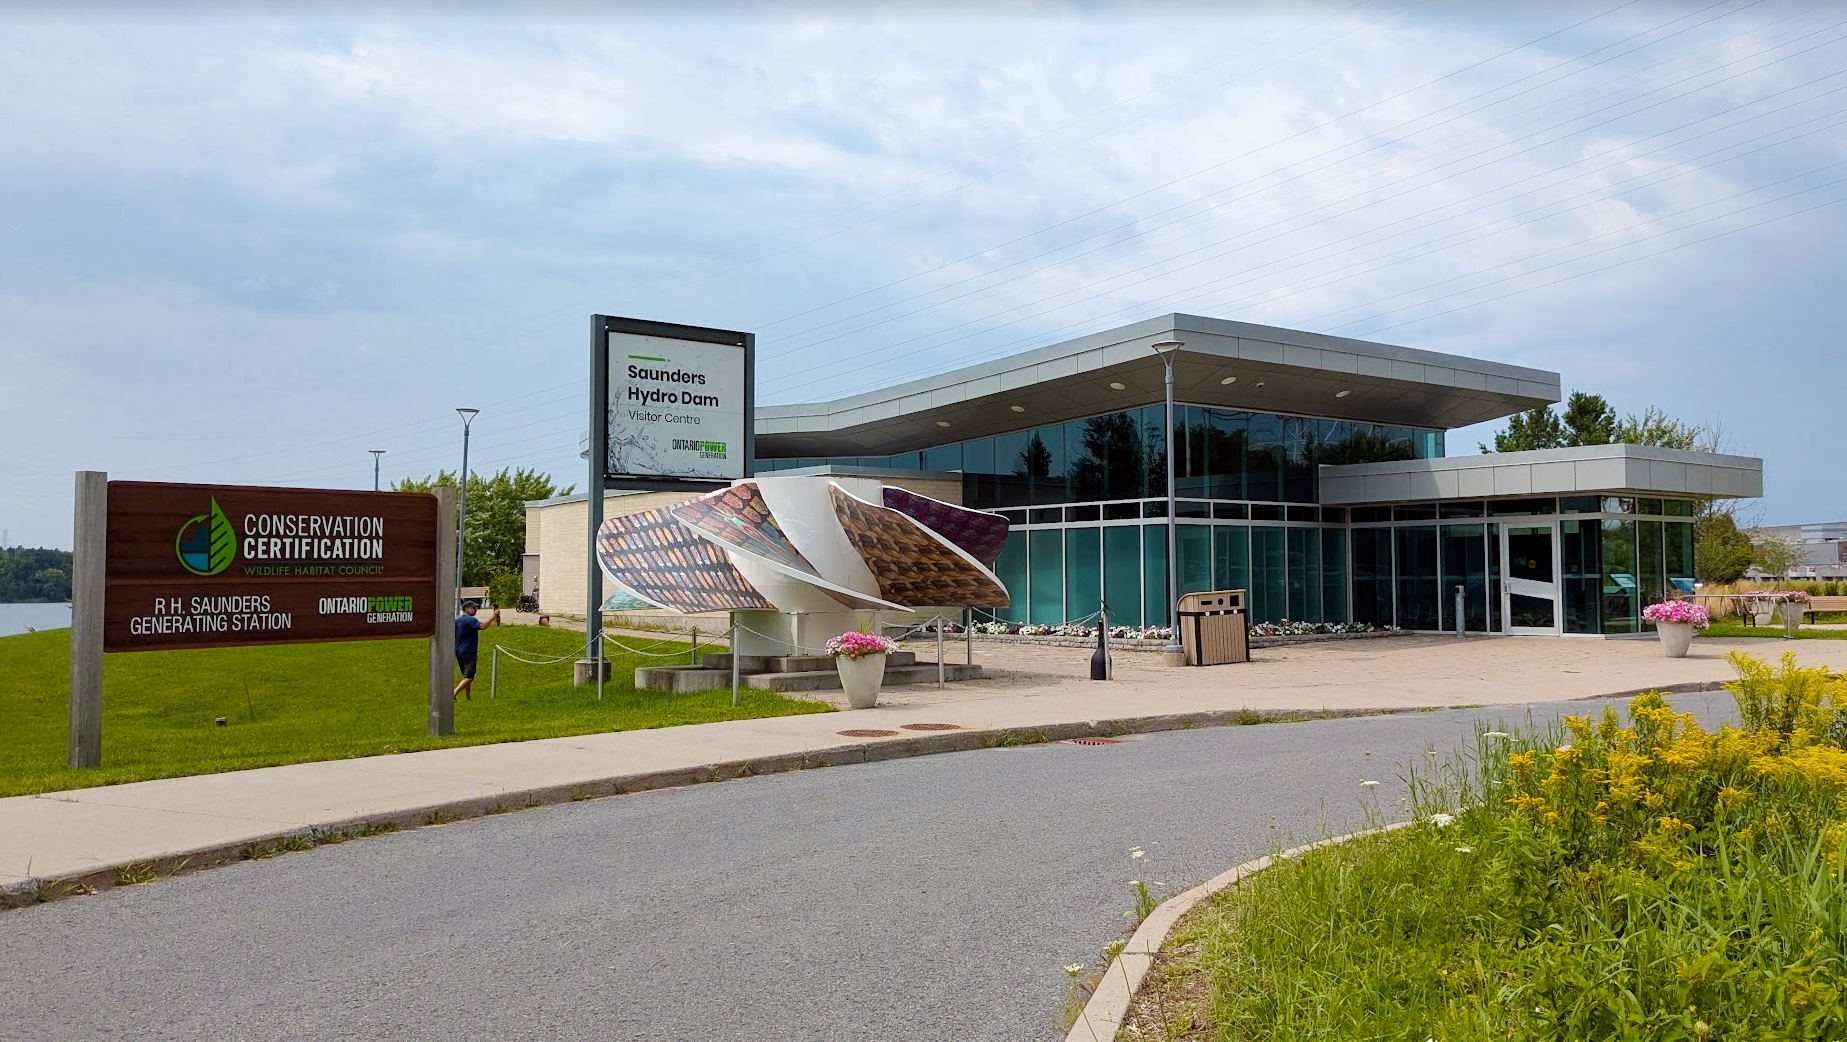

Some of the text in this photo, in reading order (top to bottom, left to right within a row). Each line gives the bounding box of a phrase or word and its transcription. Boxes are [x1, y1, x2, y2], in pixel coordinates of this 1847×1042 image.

[628, 365, 706, 385] Saunders
[628, 387, 719, 407] Hydro Dam
[628, 410, 701, 425] Visitor Centre
[244, 514, 384, 537] CONSERVATION
[243, 537, 383, 559] CERTIFICATION
[244, 566, 290, 576] WILDLIFE
[294, 566, 335, 576] HABITAT
[154, 595, 271, 615] R H. SAUNDERS
[130, 612, 292, 635] GENERATING STATION
[366, 611, 413, 624] GENERATION
